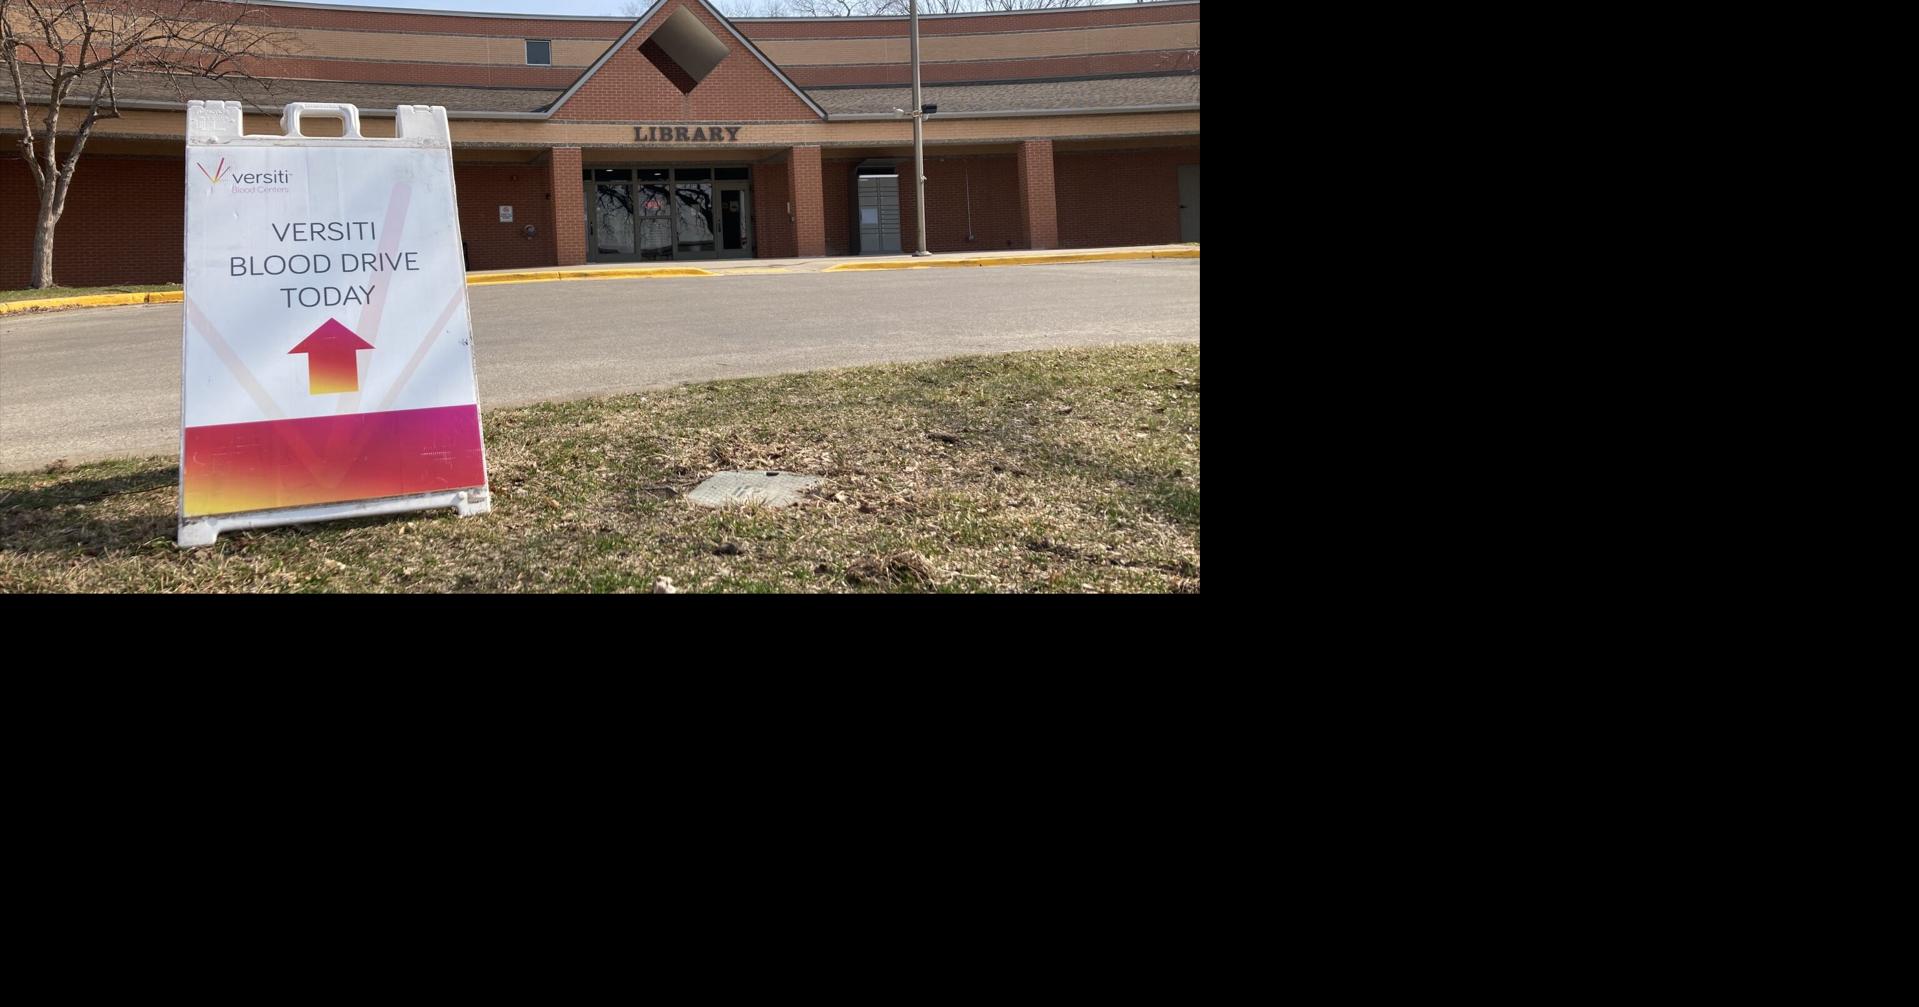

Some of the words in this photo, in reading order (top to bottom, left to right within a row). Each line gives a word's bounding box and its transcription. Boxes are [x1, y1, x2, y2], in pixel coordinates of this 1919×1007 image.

[633, 126, 742, 142] LIBRARY
[232, 170, 289, 184] versiti
[231, 185, 256, 193] Blood
[257, 185, 289, 193] Centers
[272, 221, 376, 242] VERSITI
[230, 254, 331, 276] BLOOD
[341, 252, 420, 273] DRIVE
[280, 285, 376, 308] TODAY
